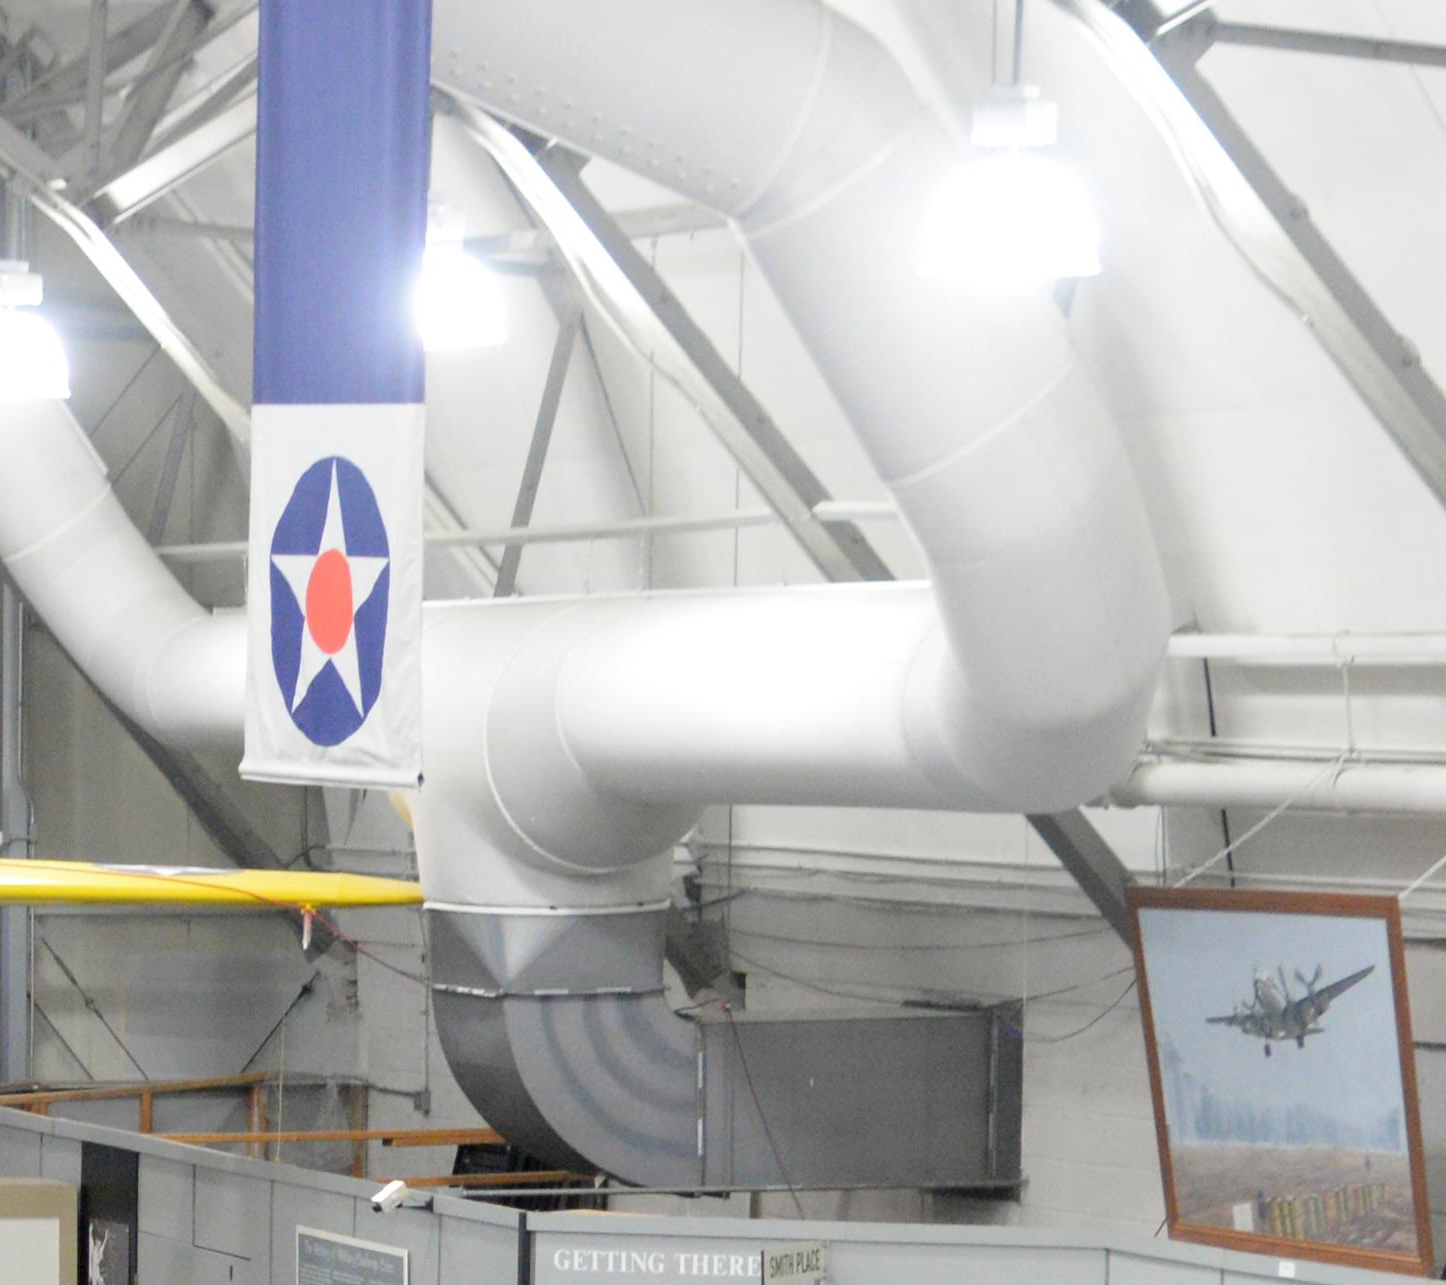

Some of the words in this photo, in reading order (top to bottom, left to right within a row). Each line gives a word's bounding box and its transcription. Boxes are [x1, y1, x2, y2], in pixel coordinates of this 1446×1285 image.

[553, 1248, 664, 1275] GETTING
[674, 1252, 762, 1277] THERE
[769, 1253, 794, 1278] SMITH
[796, 1249, 821, 1275] PLACE
